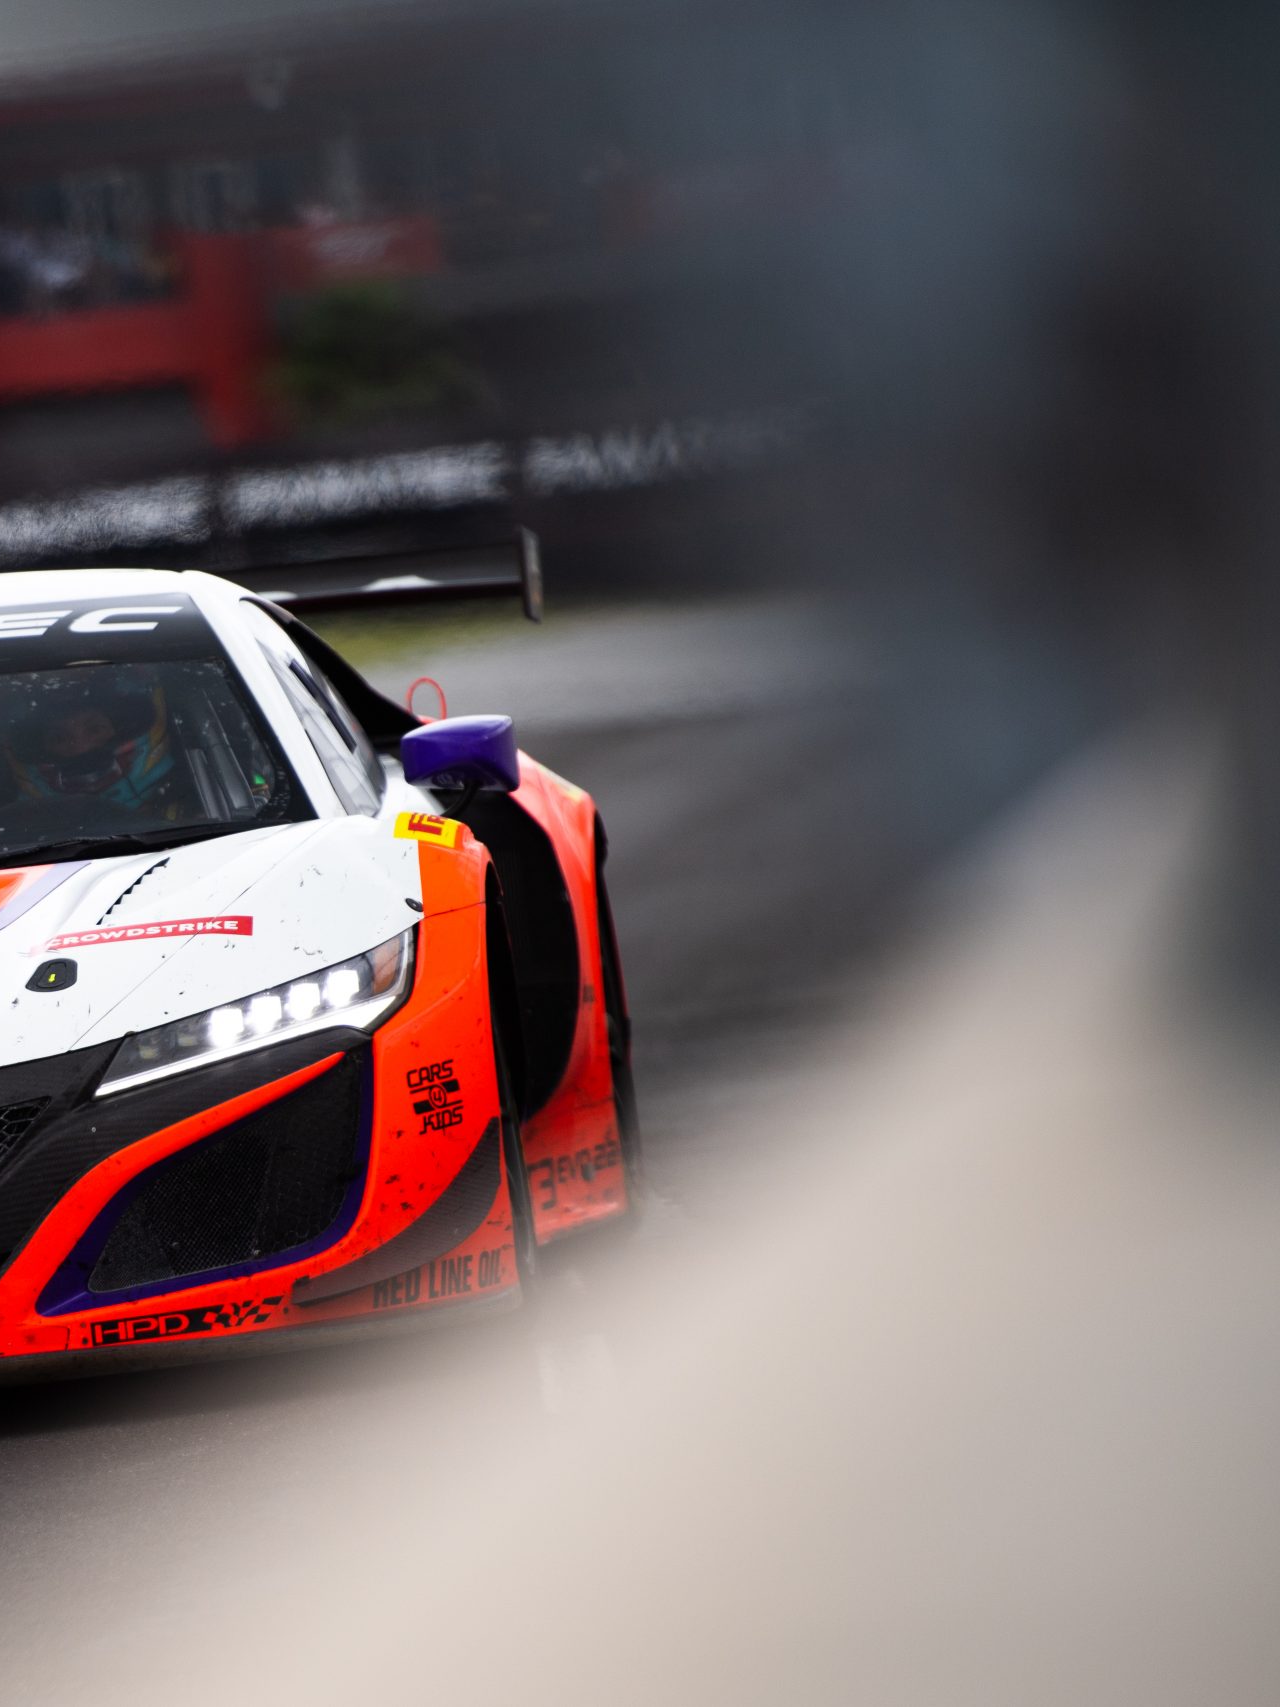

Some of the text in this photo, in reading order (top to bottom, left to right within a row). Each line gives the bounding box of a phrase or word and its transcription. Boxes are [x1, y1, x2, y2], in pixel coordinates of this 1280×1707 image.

[47, 919, 239, 948] CROWDSTRIKE
[406, 1059, 454, 1089] CARS
[419, 1105, 464, 1135] KIDS
[427, 1254, 474, 1299] LINE
[477, 1247, 502, 1289] OIL
[94, 1312, 191, 1345] HPD
